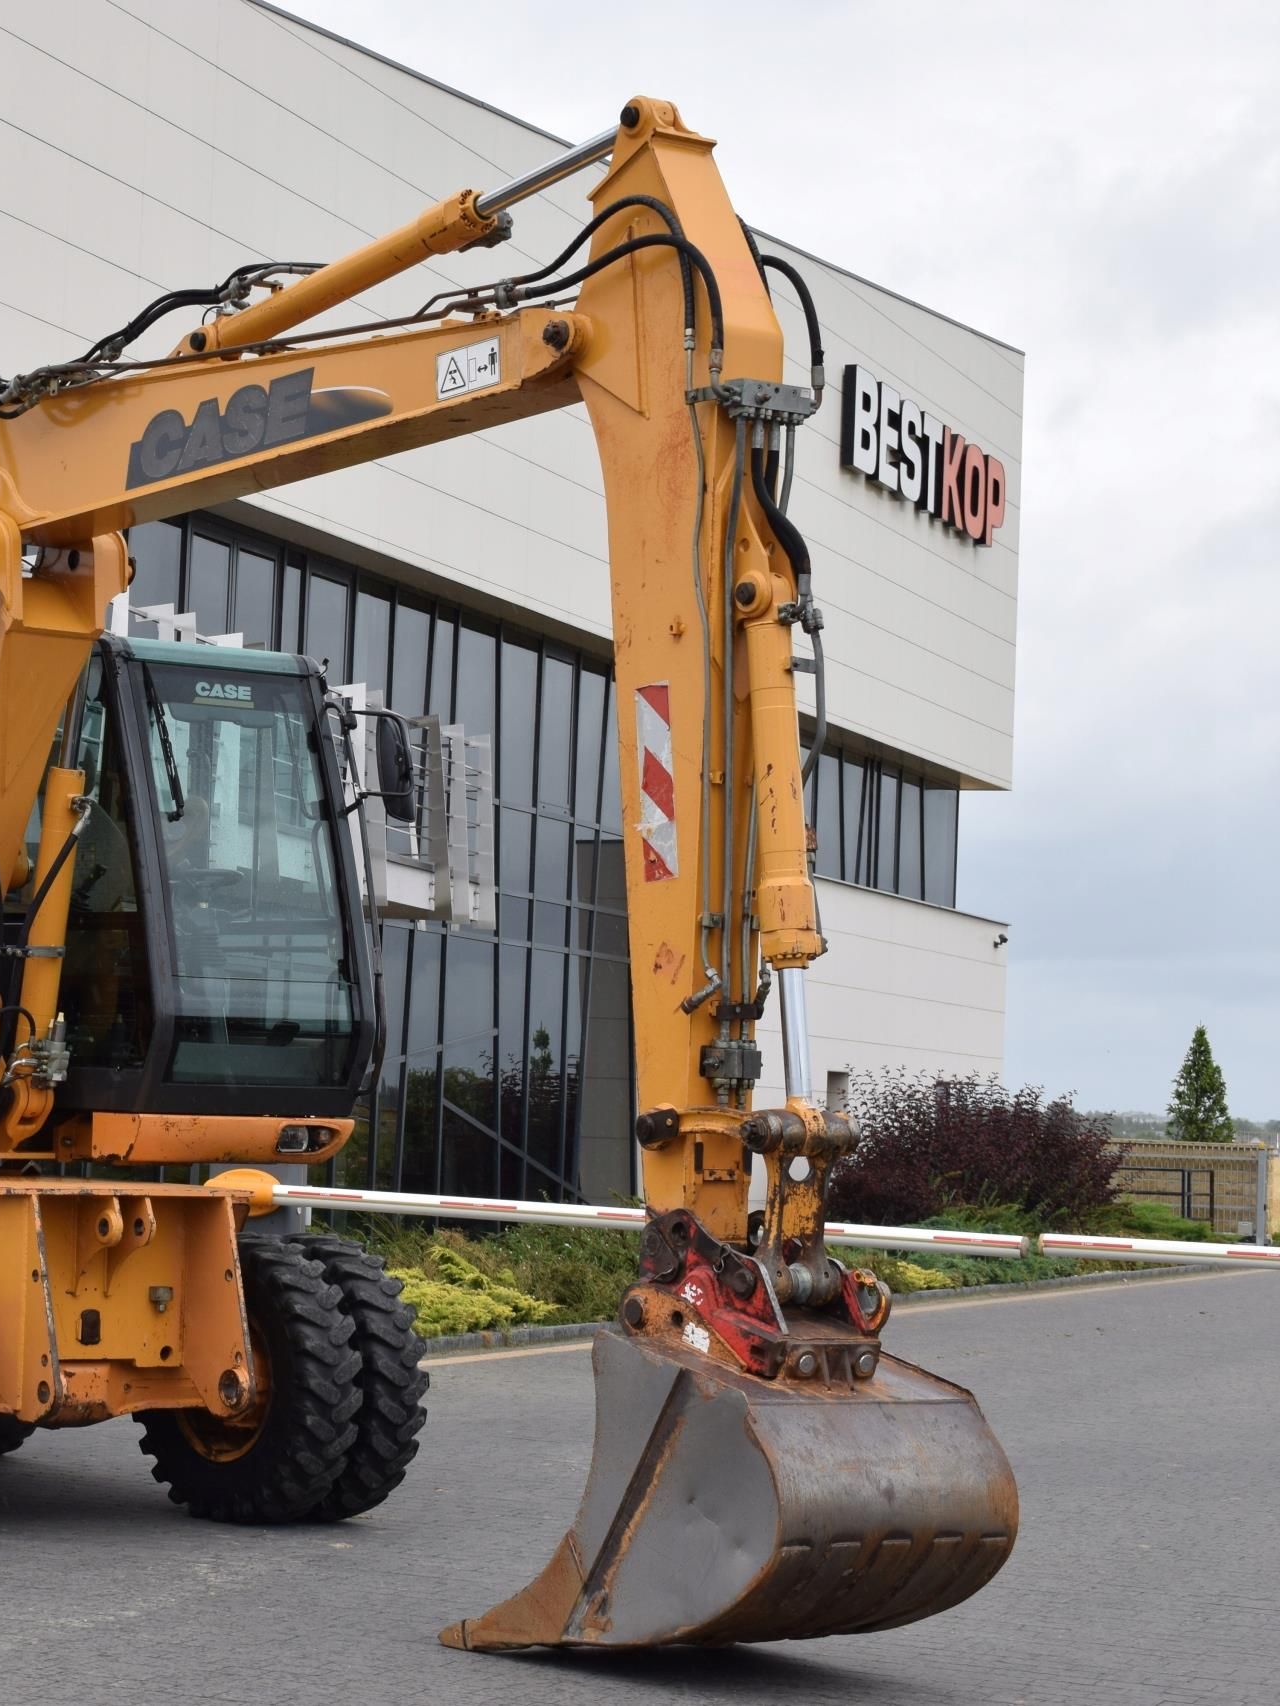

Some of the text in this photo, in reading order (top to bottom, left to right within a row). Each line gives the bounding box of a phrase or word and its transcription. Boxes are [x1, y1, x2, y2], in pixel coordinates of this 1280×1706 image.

[140, 366, 315, 478] CASE
[841, 364, 1006, 547] BESTKOP
[195, 681, 252, 701] CASE
